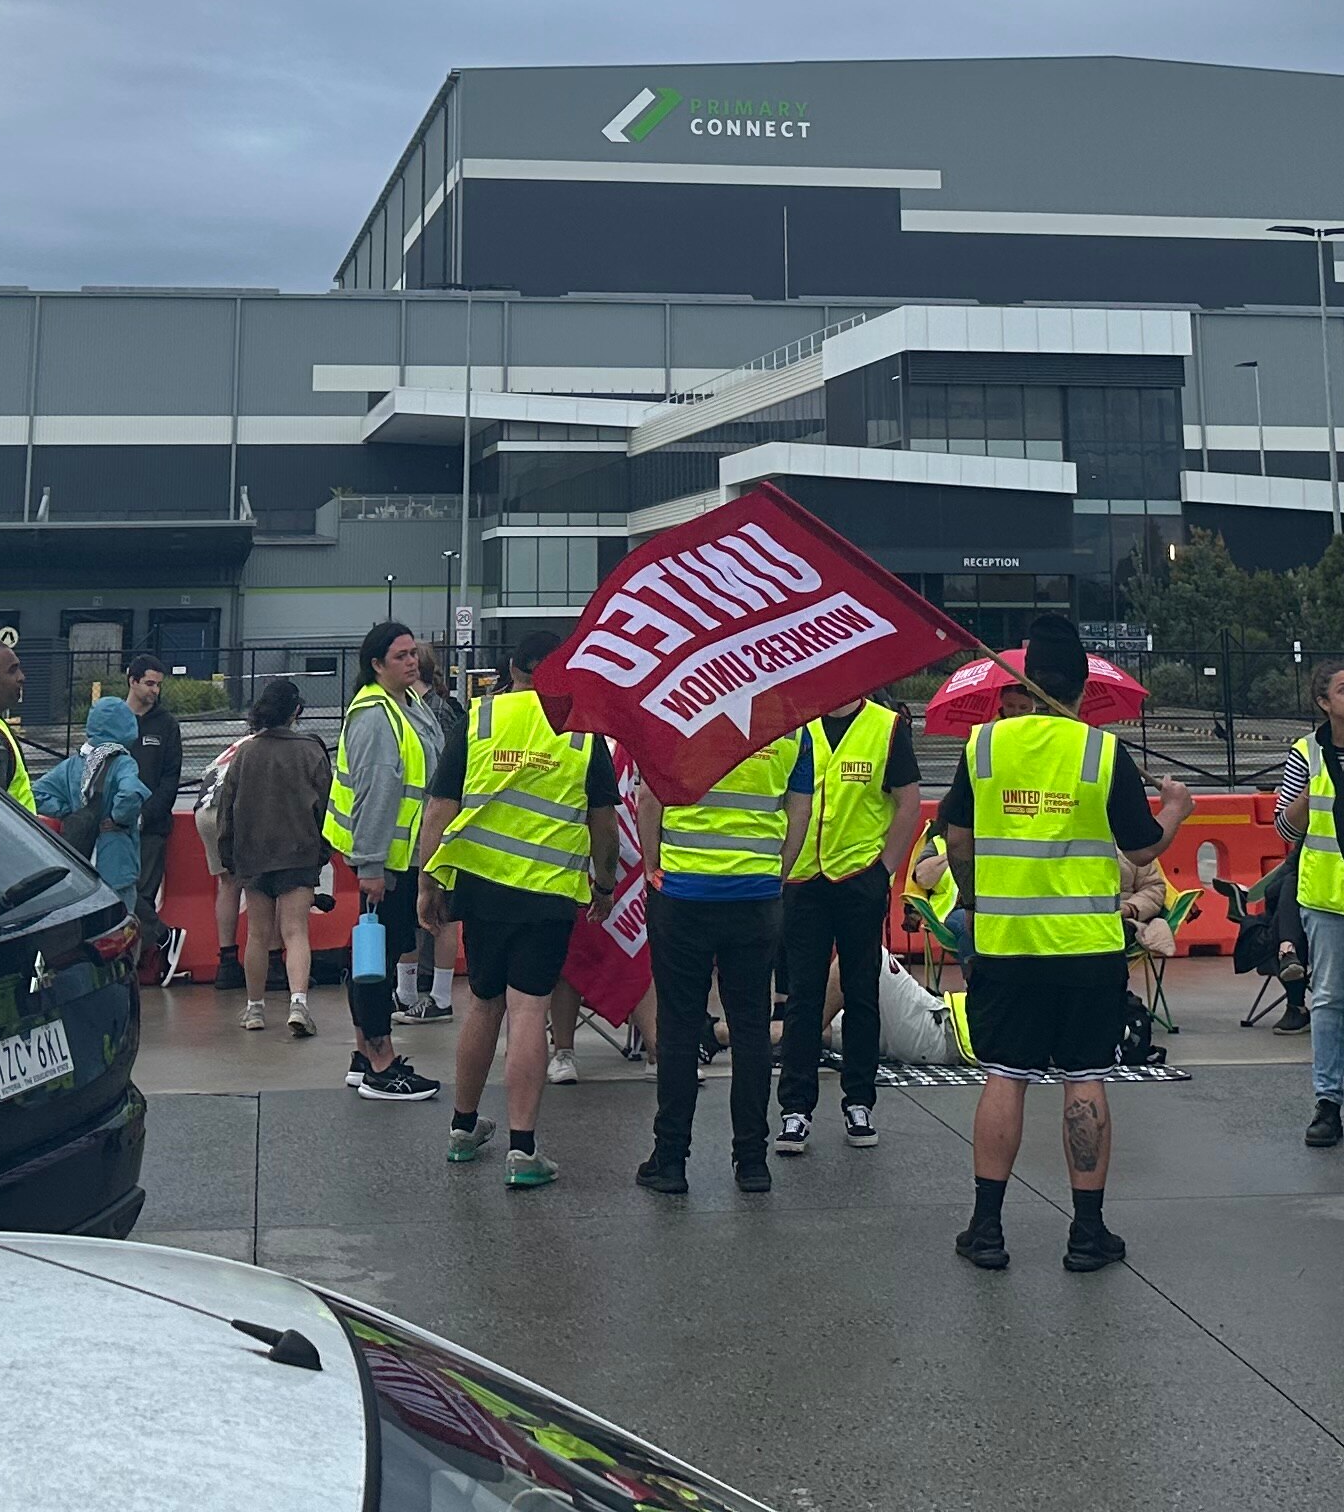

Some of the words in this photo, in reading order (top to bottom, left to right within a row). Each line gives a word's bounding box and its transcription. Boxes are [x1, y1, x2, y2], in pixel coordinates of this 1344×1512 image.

[690, 98, 808, 117] PRIMARY
[690, 118, 811, 138] CONNECT
[963, 557, 1020, 567] RECEPTION
[951, 660, 995, 683] UNITED
[840, 761, 873, 774] UNITED
[1002, 790, 1041, 805] UNITED
[37, 1027, 68, 1069] 6KL
